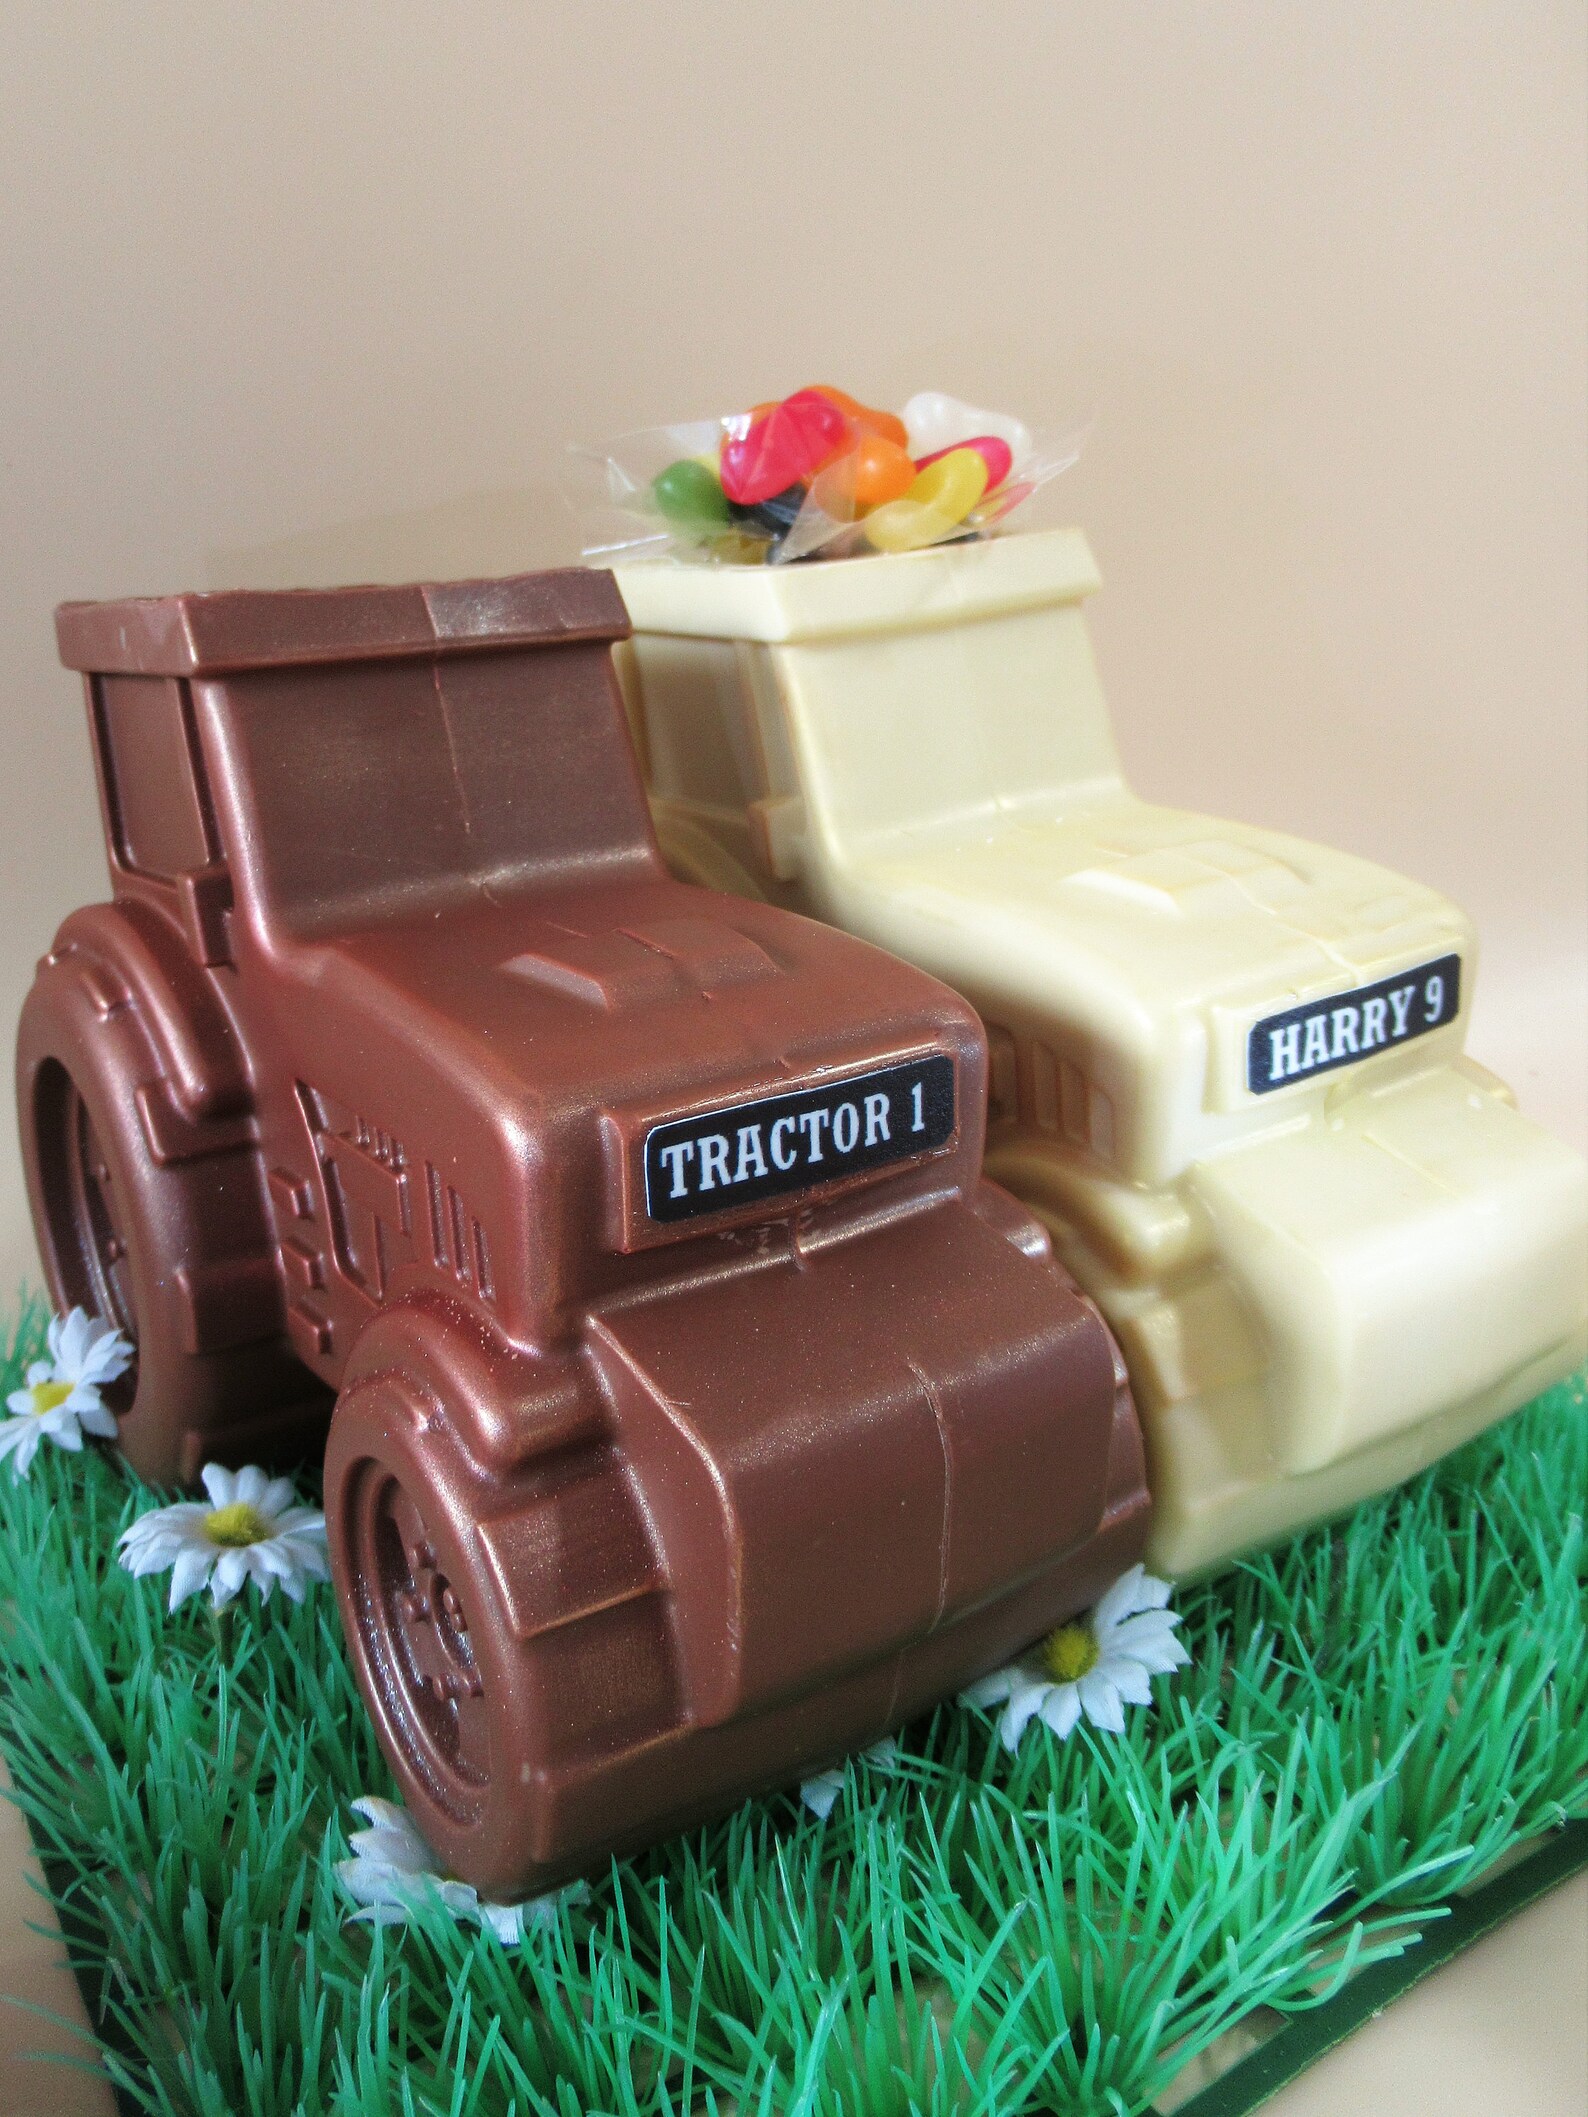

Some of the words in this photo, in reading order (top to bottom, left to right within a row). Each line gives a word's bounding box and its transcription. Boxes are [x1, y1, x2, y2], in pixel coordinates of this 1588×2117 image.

[1268, 985, 1416, 1081] HARRY
[1424, 975, 1445, 1023] 9
[660, 1092, 891, 1199] TRACTOR
[911, 1082, 925, 1132] 1
